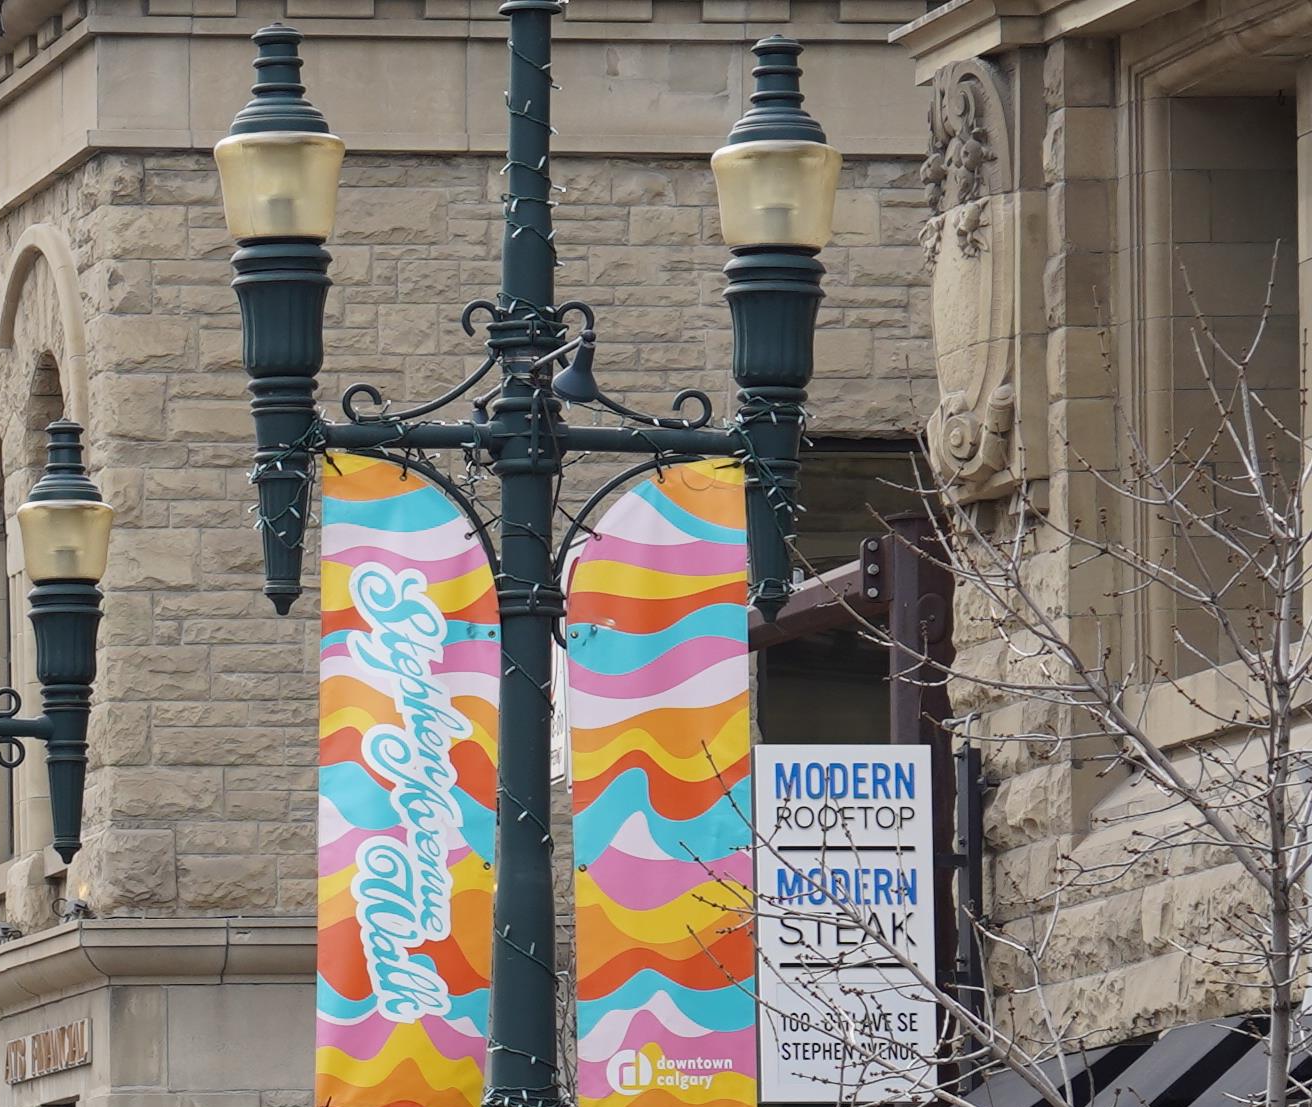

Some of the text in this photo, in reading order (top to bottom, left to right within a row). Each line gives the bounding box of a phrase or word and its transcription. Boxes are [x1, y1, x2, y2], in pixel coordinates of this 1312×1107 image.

[774, 761, 916, 801] MODERN
[355, 568, 467, 1019] Stephen Avenue Walk
[776, 806, 916, 830] ROOFTOP
[777, 867, 918, 906] MODERN
[778, 912, 917, 947] STEAK
[897, 1012, 918, 1032] SE
[656, 1055, 733, 1070] downtown
[781, 1042, 853, 1060] STEPHEN
[656, 1071, 714, 1090] calgary
